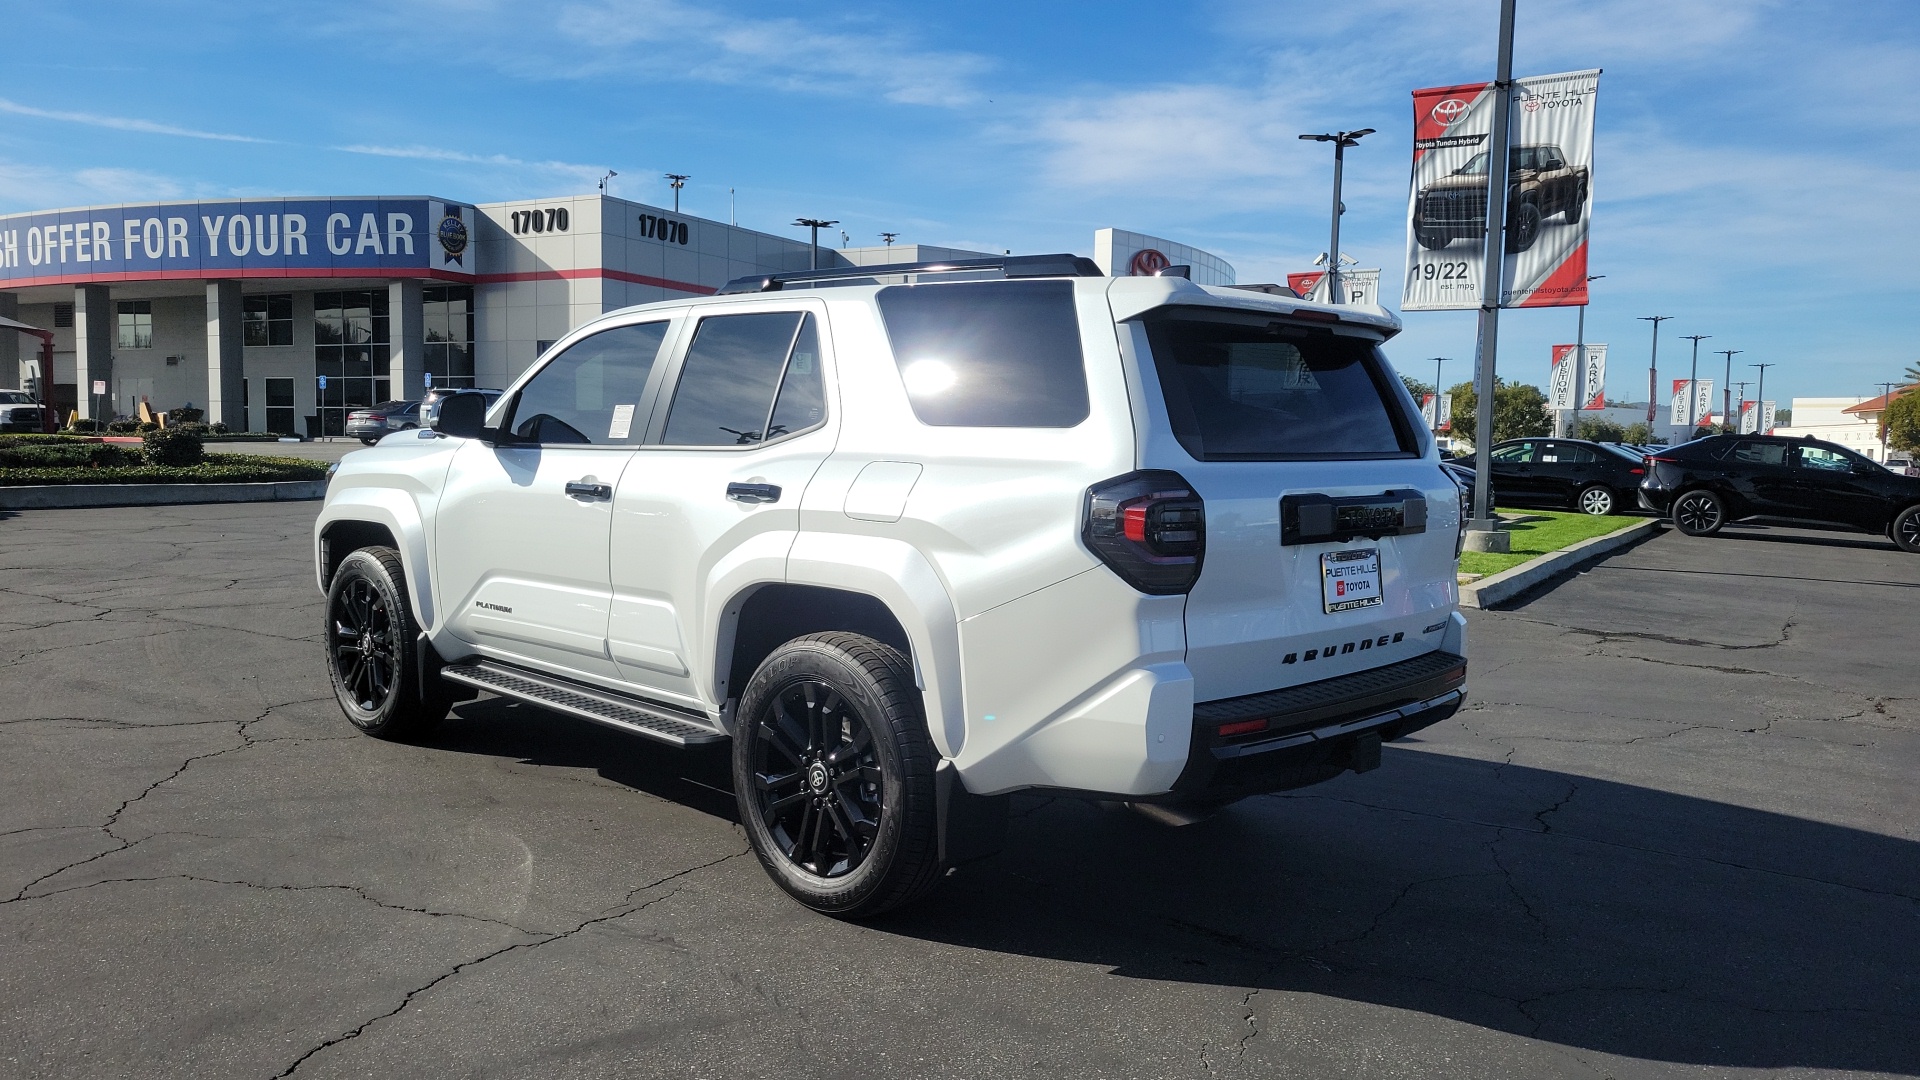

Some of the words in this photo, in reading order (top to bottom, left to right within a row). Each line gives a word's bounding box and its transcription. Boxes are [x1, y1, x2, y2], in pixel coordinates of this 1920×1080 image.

[1513, 91, 1561, 103] PUENTE
[1566, 87, 1596, 97] HILLS
[1541, 98, 1582, 109] TOYOTA
[1436, 139, 1457, 147] Tundra
[1458, 138, 1479, 146] Hybrid
[442, 219, 465, 232] KELLEY
[511, 207, 570, 235] 17070
[638, 213, 689, 246] 17070
[0, 229, 19, 268] H
[27, 221, 112, 266] OFFER
[124, 217, 190, 260] FOR
[202, 213, 309, 257] YOUR
[326, 212, 415, 256] CAR
[1412, 262, 1468, 281] 19/22
[1456, 283, 1475, 291] mpg
[1503, 286, 1588, 296] puentehillstoyota.com
[1557, 355, 1568, 407] CUSTOMER
[1587, 355, 1598, 406] PARKING
[1698, 387, 1707, 423] PARKING
[1350, 506, 1398, 527] TOYOTA
[1336, 551, 1367, 561] TOYOTA
[1326, 566, 1356, 578] PUENTE
[1356, 563, 1377, 575] HILLS
[1346, 580, 1371, 592] TOYOTA
[475, 600, 513, 614] PLATINUM
[1329, 601, 1360, 611] PUENTE
[1360, 597, 1381, 607] HILLS
[1281, 631, 1405, 665] 4RUNNER
